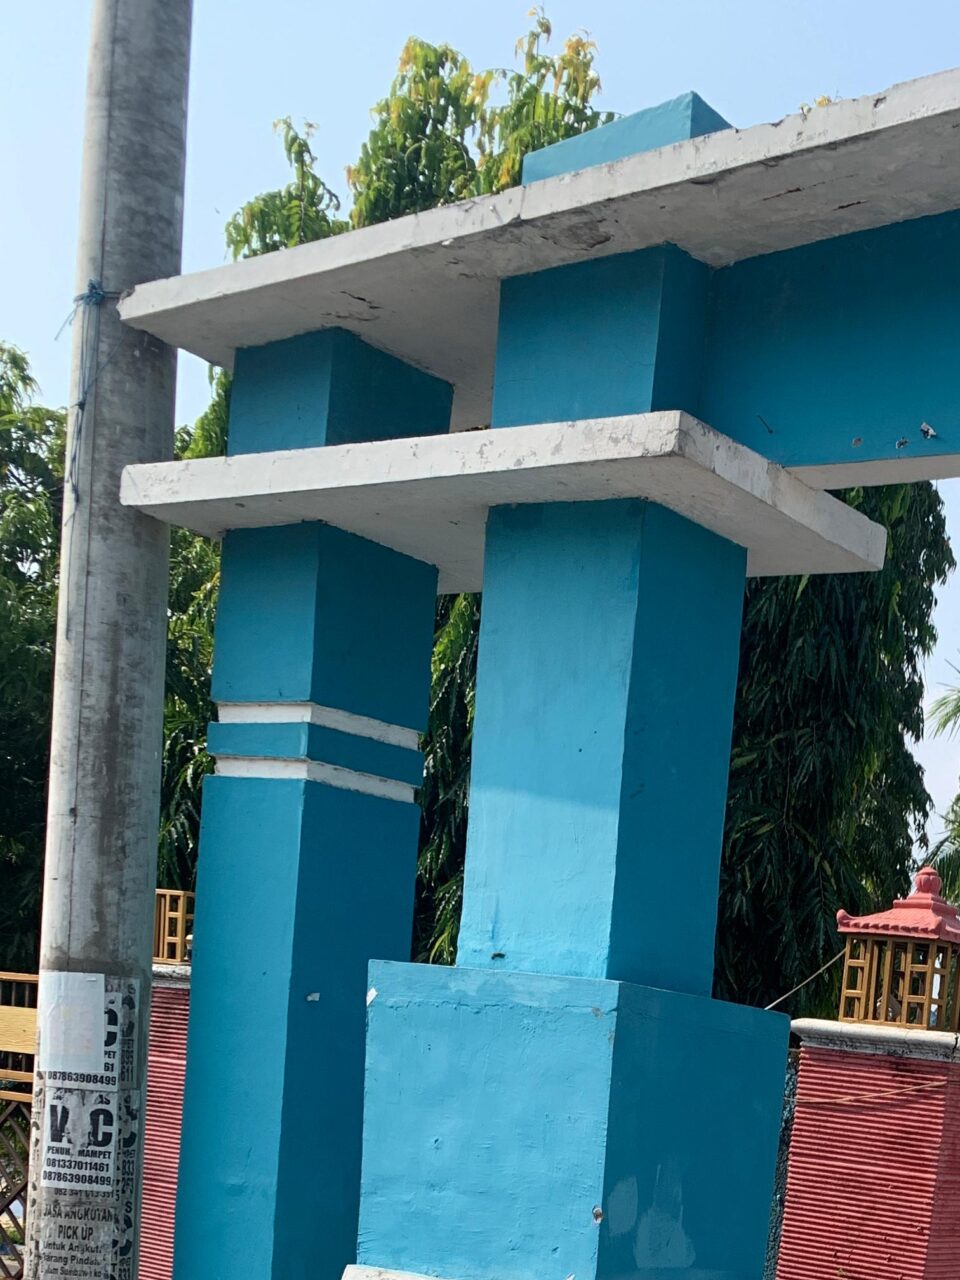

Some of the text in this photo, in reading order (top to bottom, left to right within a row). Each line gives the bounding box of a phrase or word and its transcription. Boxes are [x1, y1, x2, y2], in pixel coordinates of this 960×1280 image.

[48, 1071, 117, 1086] 087863908499
[47, 1146, 71, 1156] PENUH
[77, 1149, 112, 1159] MAMPET
[46, 1158, 109, 1172] 081337011461
[43, 1170, 112, 1186] 087863908499
[57, 1224, 94, 1241] PICK UP
